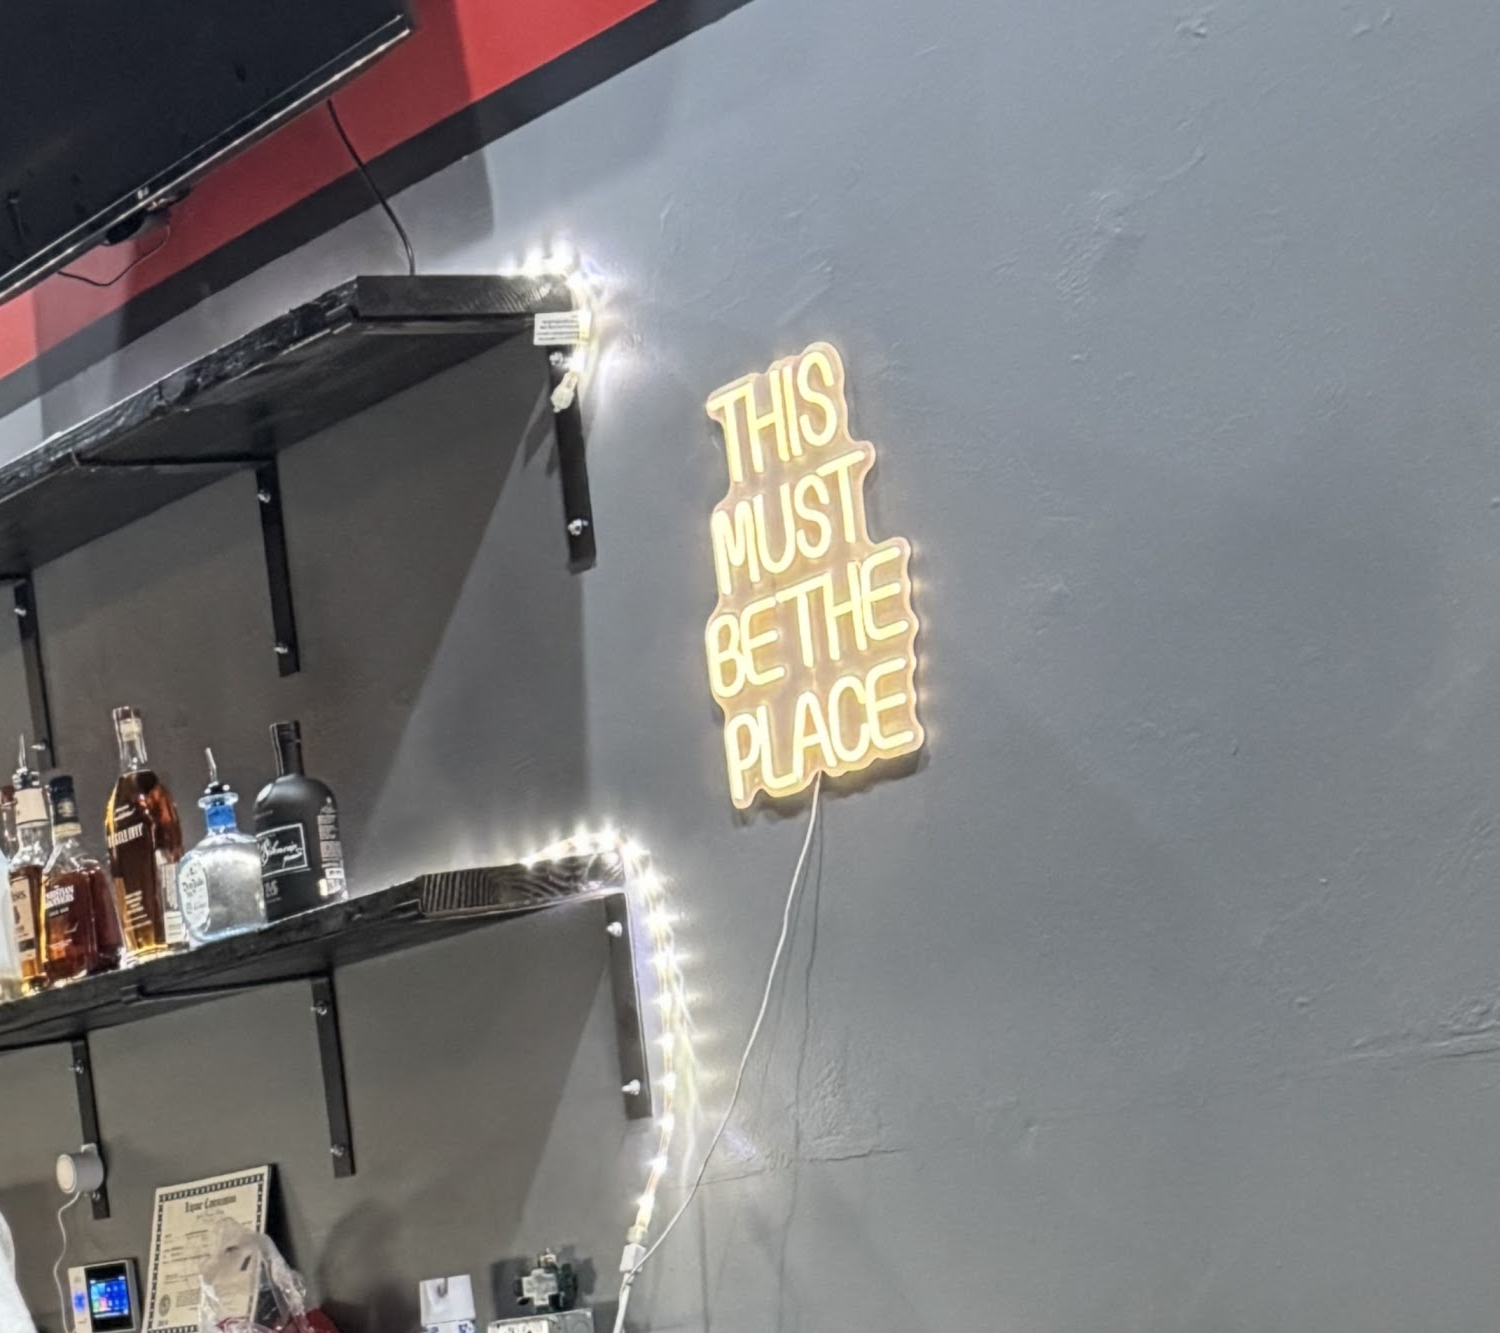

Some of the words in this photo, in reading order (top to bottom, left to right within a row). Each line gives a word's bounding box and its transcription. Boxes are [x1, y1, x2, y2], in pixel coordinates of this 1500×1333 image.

[706, 349, 839, 484] THIS
[711, 449, 867, 596] MUST
[706, 597, 786, 700] BE
[775, 546, 909, 669] THE
[723, 657, 916, 801] PLACE
